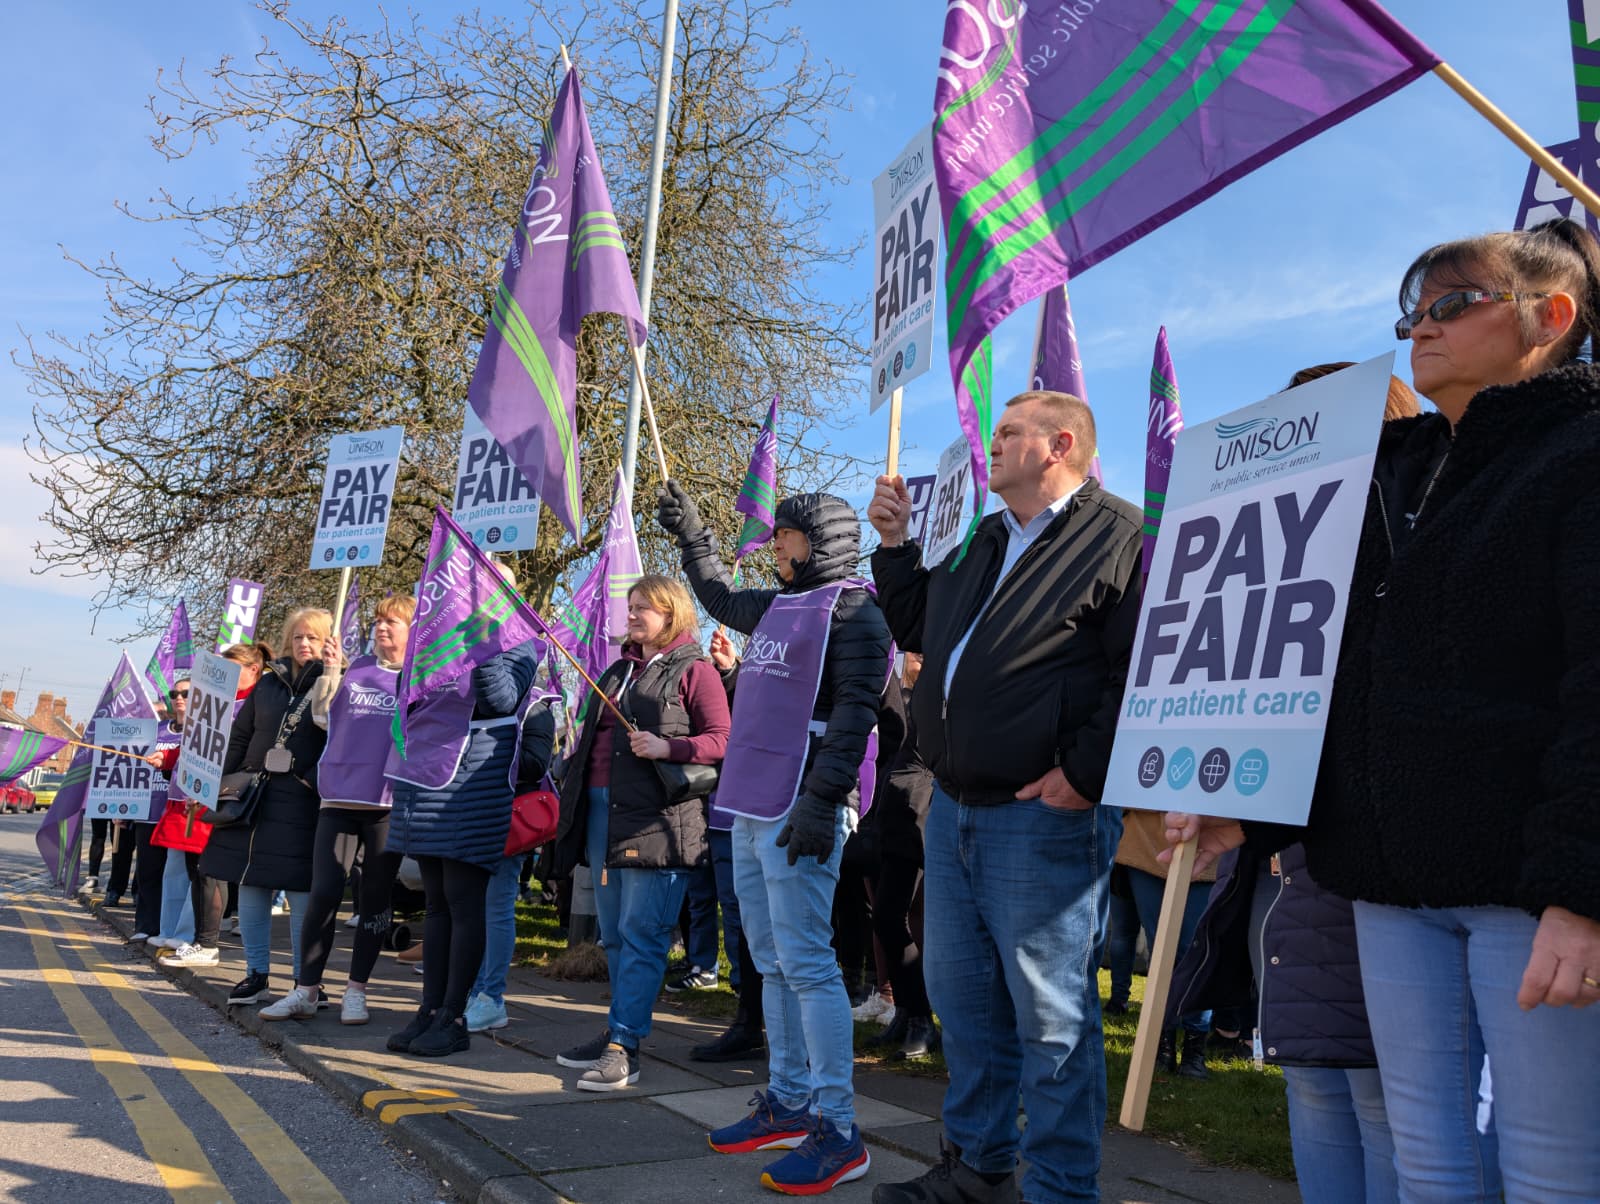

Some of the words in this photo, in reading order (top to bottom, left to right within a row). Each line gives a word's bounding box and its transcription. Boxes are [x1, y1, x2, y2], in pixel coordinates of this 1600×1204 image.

[880, 181, 934, 284] PAY
[874, 239, 934, 342] FAIR
[909, 298, 932, 326] care
[348, 440, 385, 455] UNISON
[1215, 411, 1320, 472] UNISON
[331, 463, 390, 499] PAY
[456, 465, 537, 511] FAIR
[937, 462, 970, 518] PAY
[1210, 480, 1224, 493] the
[1224, 470, 1252, 492] public
[1253, 463, 1287, 479] service
[1289, 452, 1320, 467] union
[320, 494, 388, 529] FAIR
[468, 503, 506, 523] patient
[508, 503, 537, 514] care
[927, 495, 964, 553] FAIR
[317, 530, 330, 540] for
[331, 528, 364, 543] patient
[364, 525, 385, 538] care
[1164, 478, 1345, 602] PAY
[1134, 579, 1336, 688] FAIR
[200, 663, 228, 685] UNISON
[189, 687, 229, 731] PAY
[1126, 693, 1157, 718] for
[1158, 688, 1247, 724] patient
[1252, 690, 1321, 715] care
[111, 726, 142, 735] UNISON
[182, 716, 226, 767] FAIR
[101, 745, 150, 767] PAY
[207, 764, 221, 779] care
[93, 767, 151, 789] FAIR
[103, 788, 131, 798] patient
[132, 789, 150, 797] care
